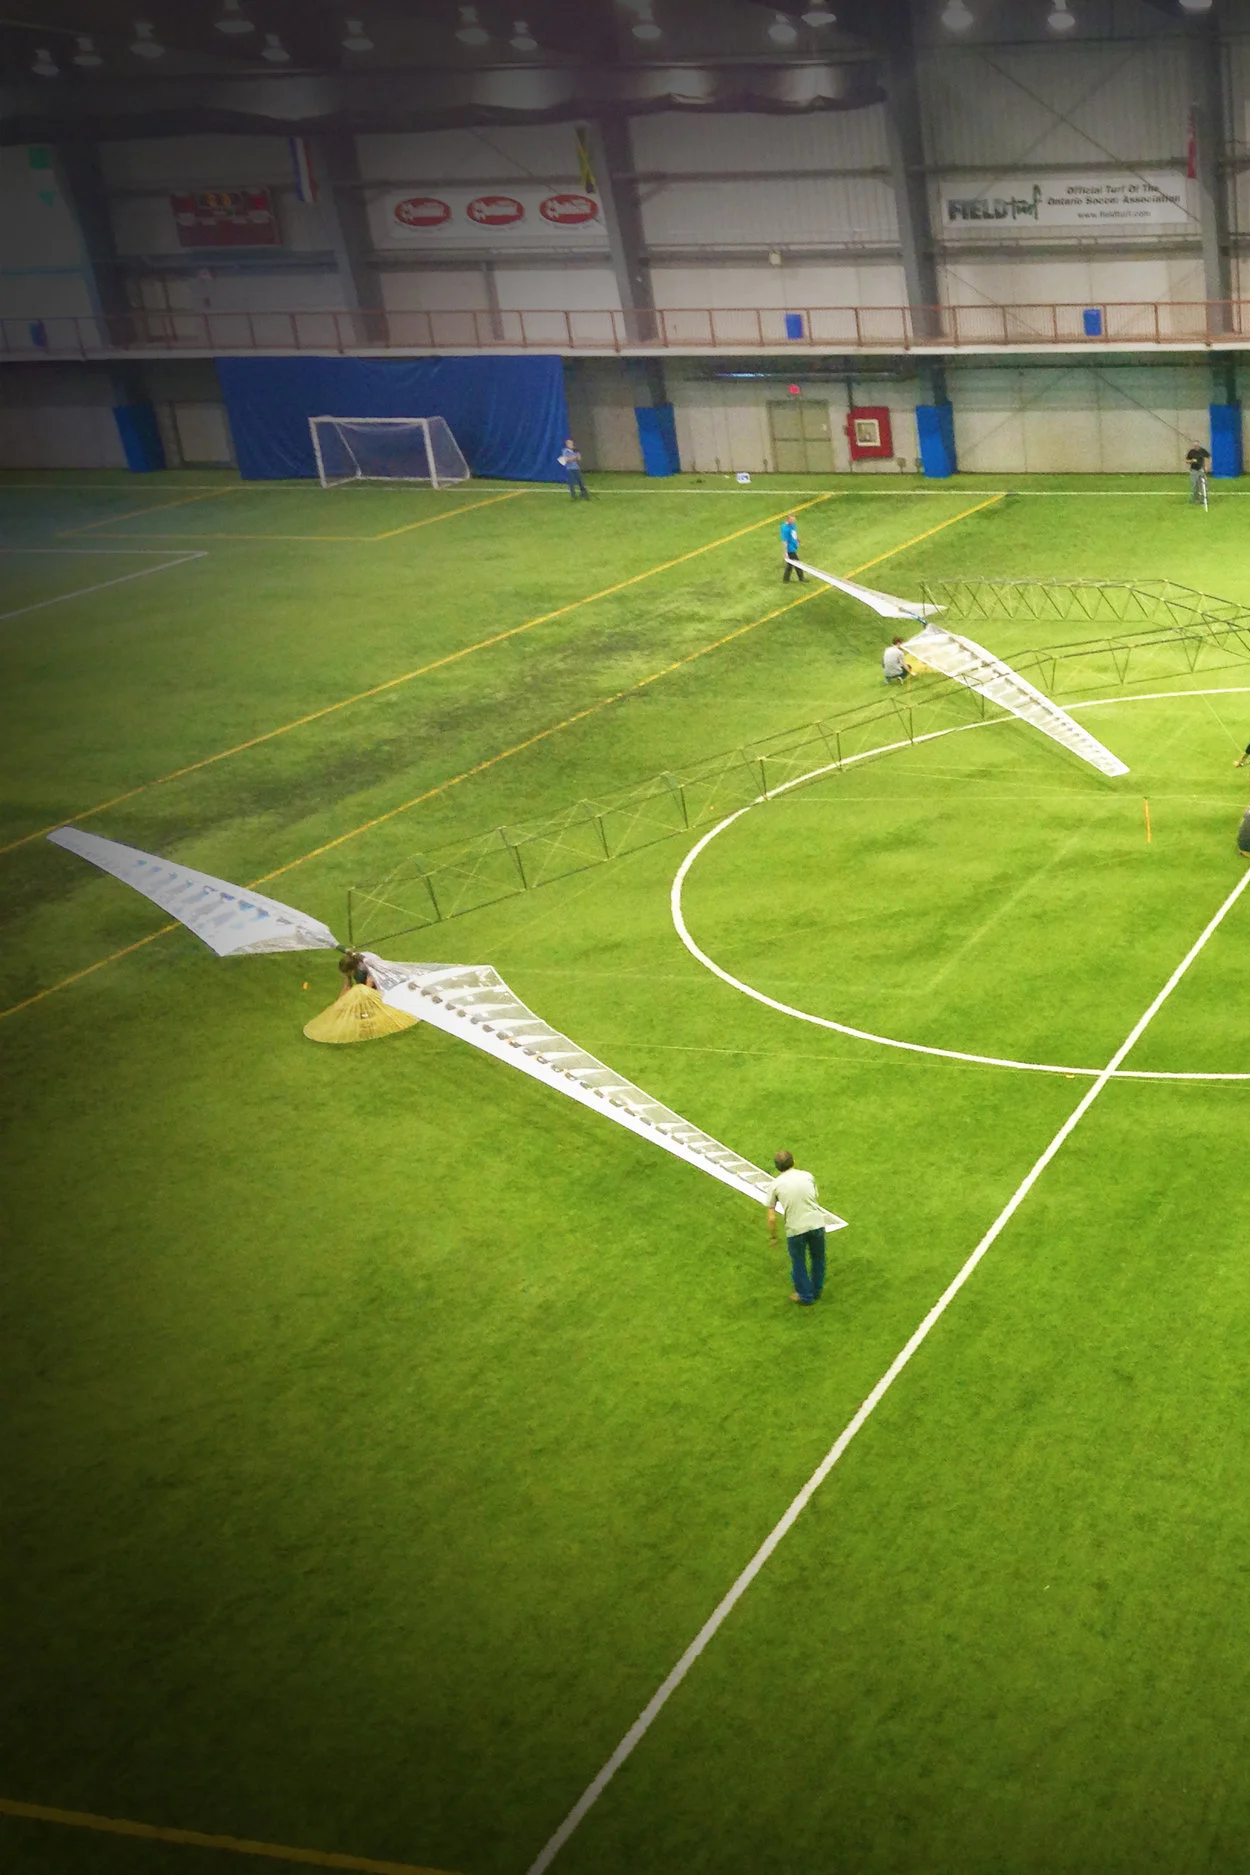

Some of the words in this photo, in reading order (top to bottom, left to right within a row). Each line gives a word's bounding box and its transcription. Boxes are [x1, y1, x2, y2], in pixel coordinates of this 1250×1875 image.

[1066, 185, 1102, 195] Official
[1105, 184, 1124, 194] Turf
[1047, 196, 1082, 206] Ontario
[1085, 196, 1118, 205] Soccer
[1122, 194, 1180, 205] Association
